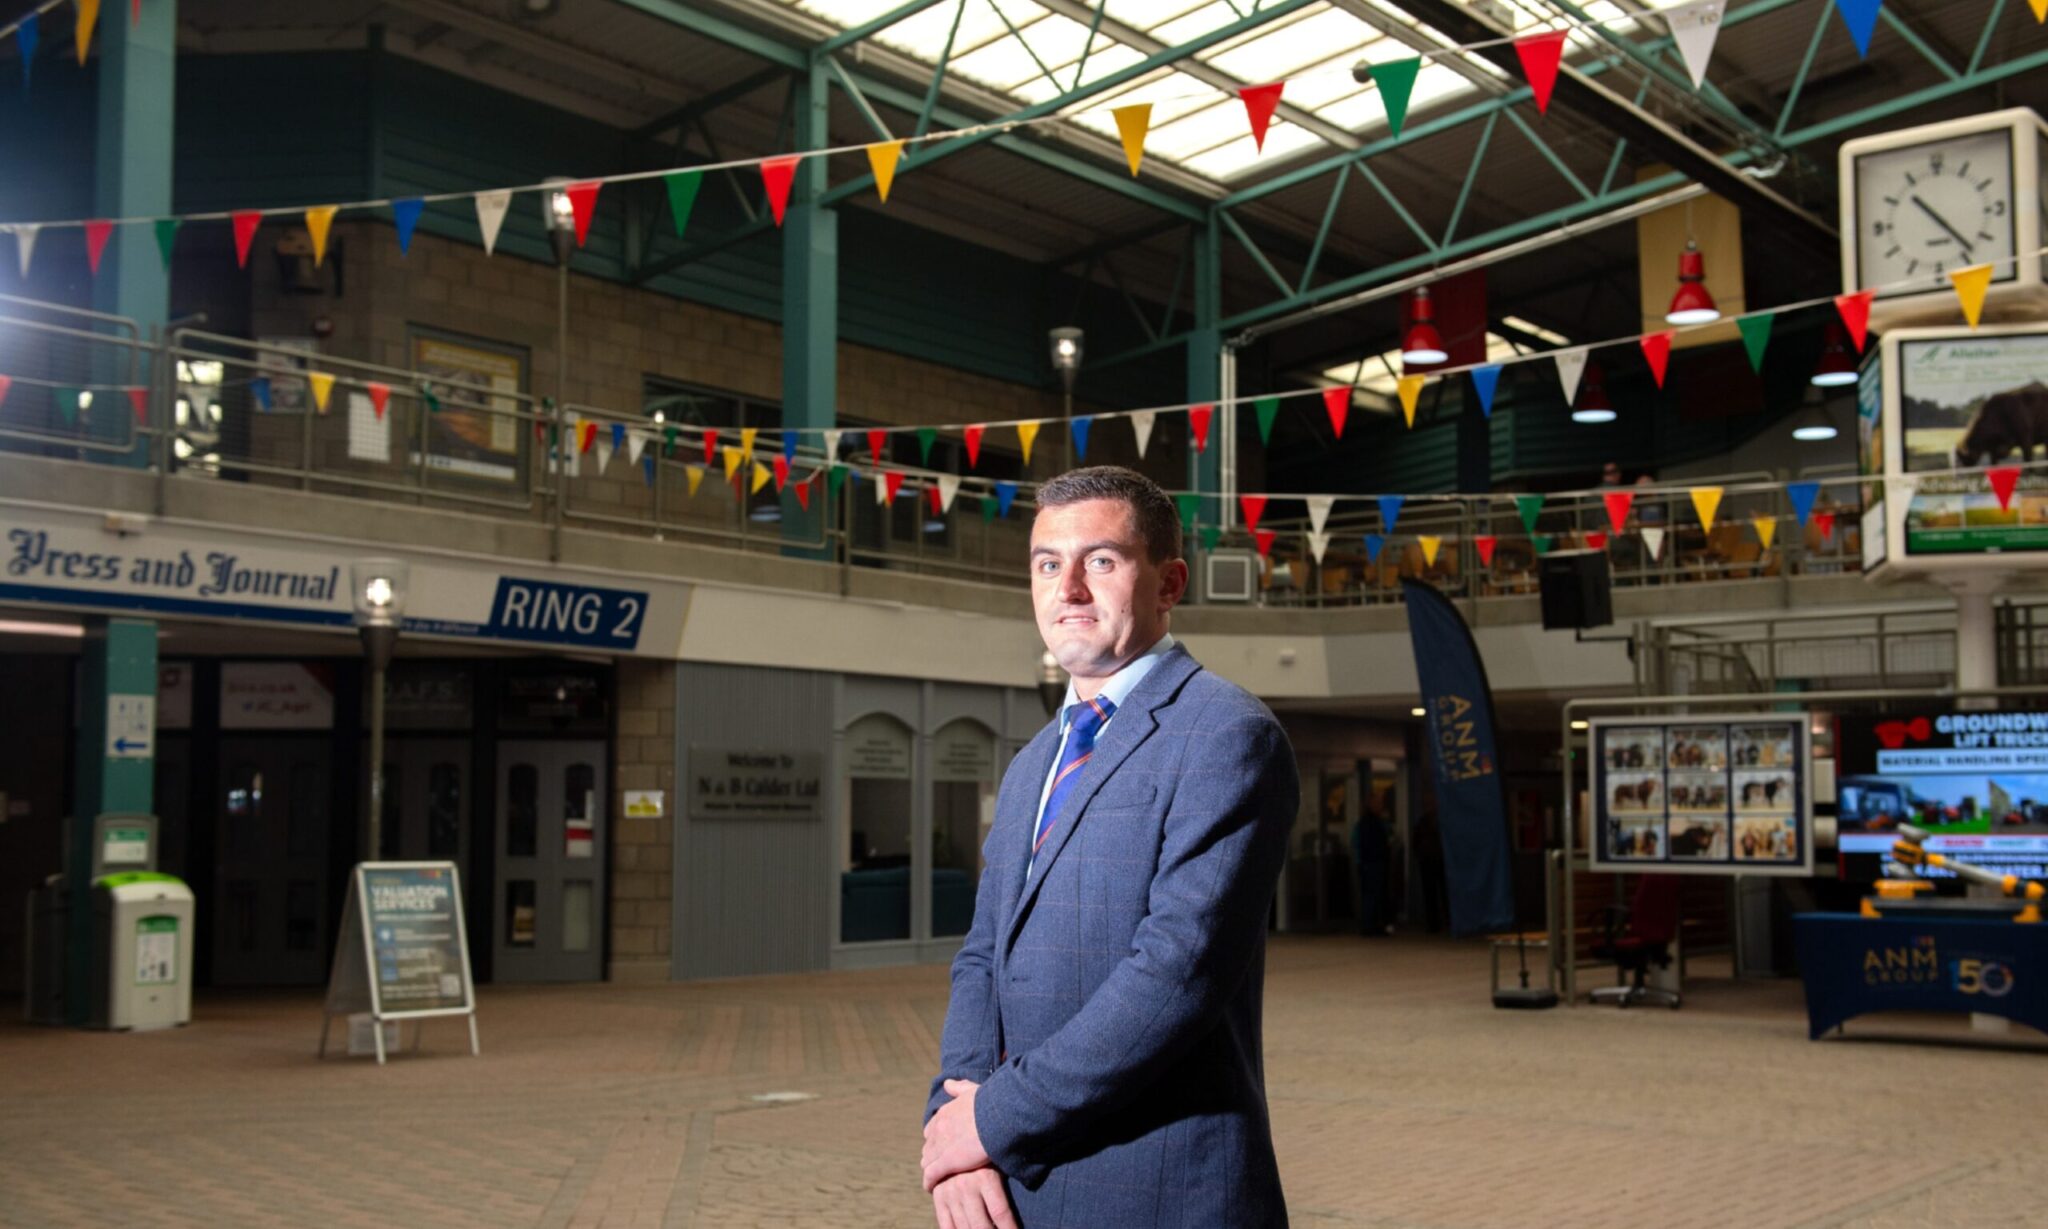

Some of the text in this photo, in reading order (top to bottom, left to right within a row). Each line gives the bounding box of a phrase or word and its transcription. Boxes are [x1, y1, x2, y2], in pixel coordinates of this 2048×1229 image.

[8, 528, 339, 601] Press and Journal
[501, 585, 639, 638] RING 2
[1448, 694, 1482, 779] ANM
[1954, 732, 1990, 748] LIFT
[1883, 755, 1941, 766] MATERIAL
[1947, 754, 2011, 765] HANDLING
[1863, 948, 1938, 971] ANM
